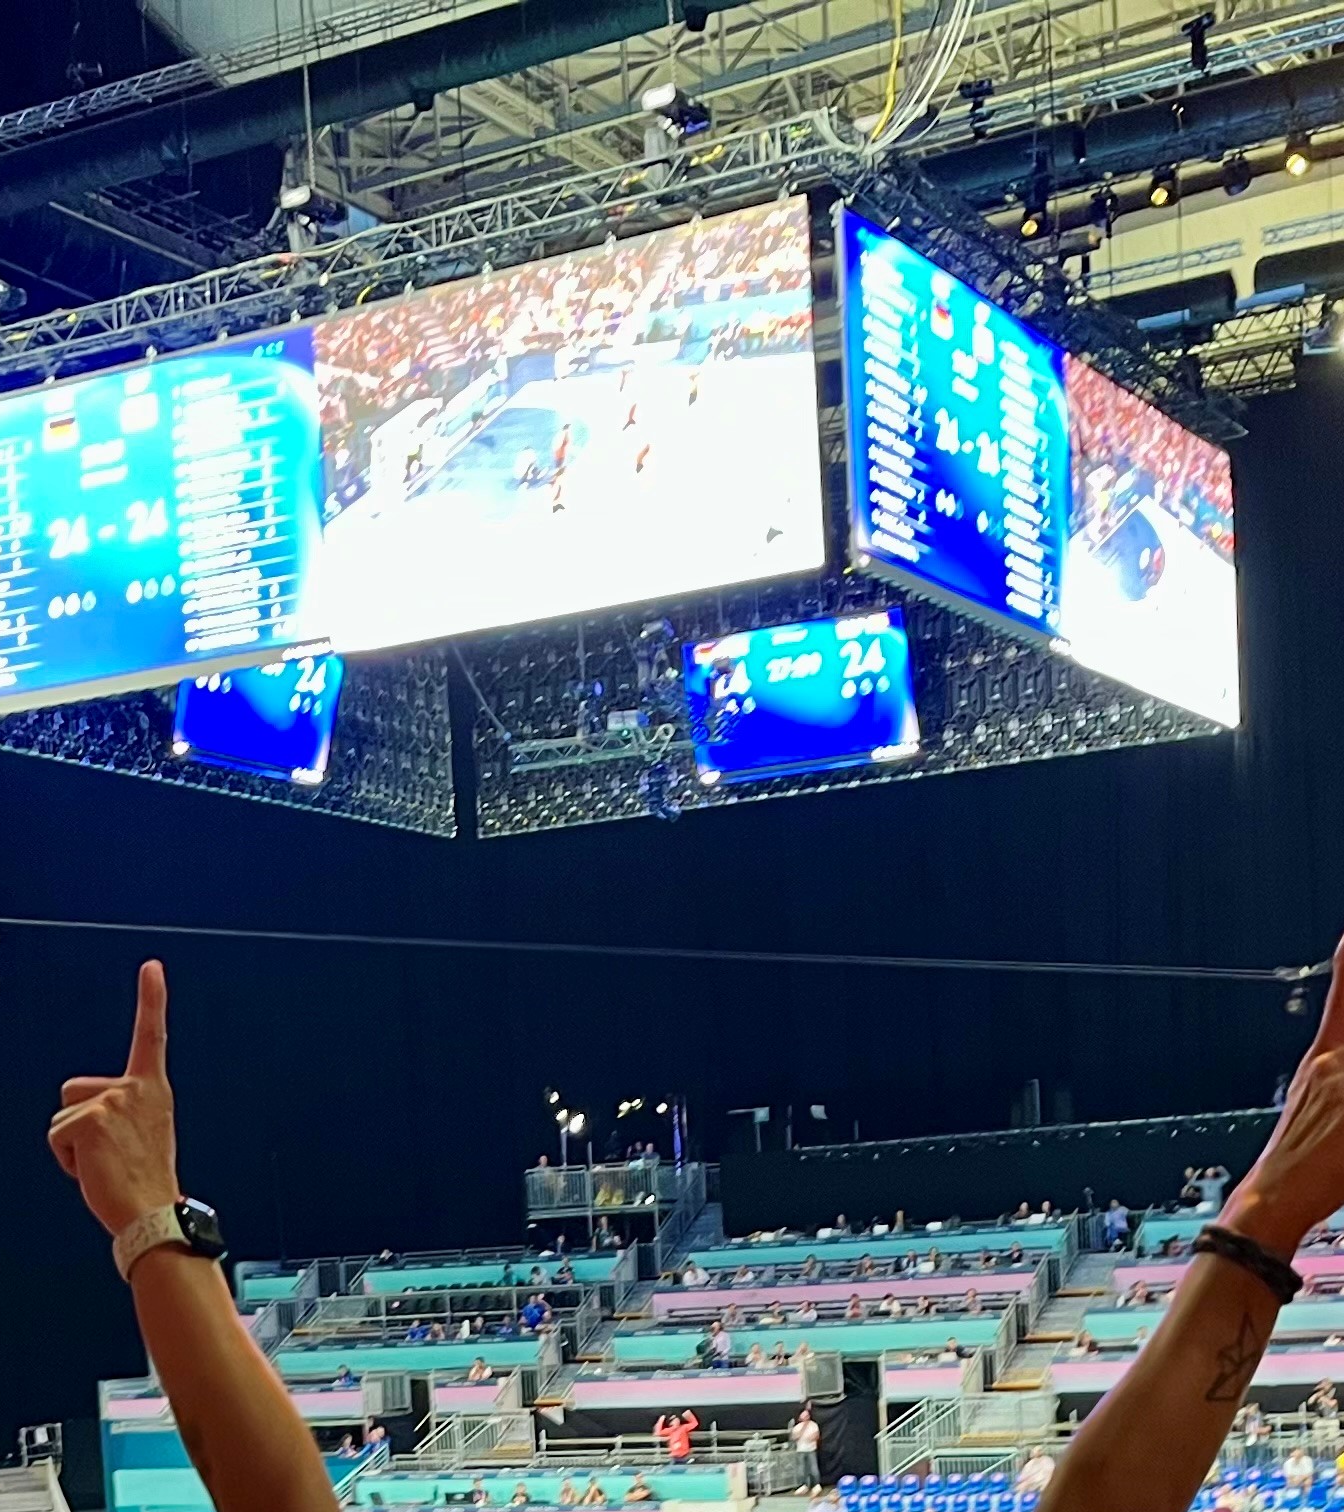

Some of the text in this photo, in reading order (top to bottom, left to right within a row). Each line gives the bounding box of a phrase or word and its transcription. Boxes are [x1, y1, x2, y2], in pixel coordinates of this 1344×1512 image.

[47, 513, 91, 560] 24
[126, 498, 169, 544] 24
[294, 656, 327, 696] 24
[839, 636, 886, 679] 24
